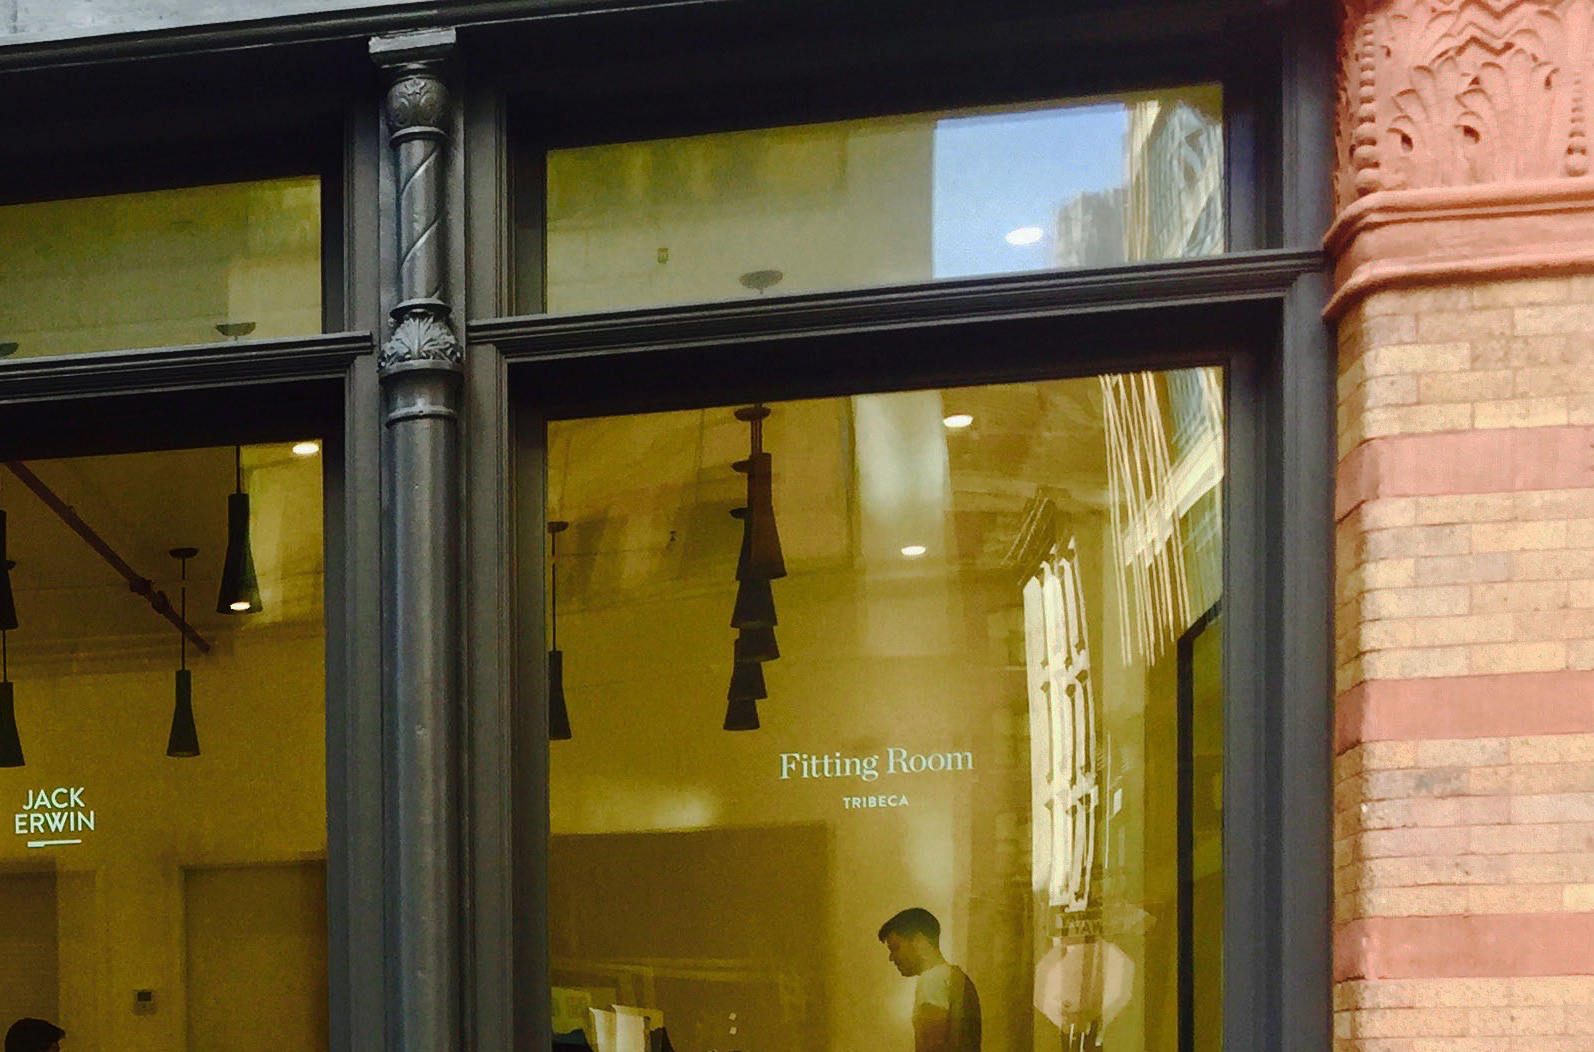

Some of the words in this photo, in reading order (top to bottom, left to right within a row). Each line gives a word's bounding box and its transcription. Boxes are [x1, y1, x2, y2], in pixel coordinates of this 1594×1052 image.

[779, 751, 880, 782] Fitting
[886, 747, 975, 774] Room
[22, 786, 86, 810] JACK
[843, 794, 910, 810] TRIBECA
[14, 810, 96, 835] ERWIN
